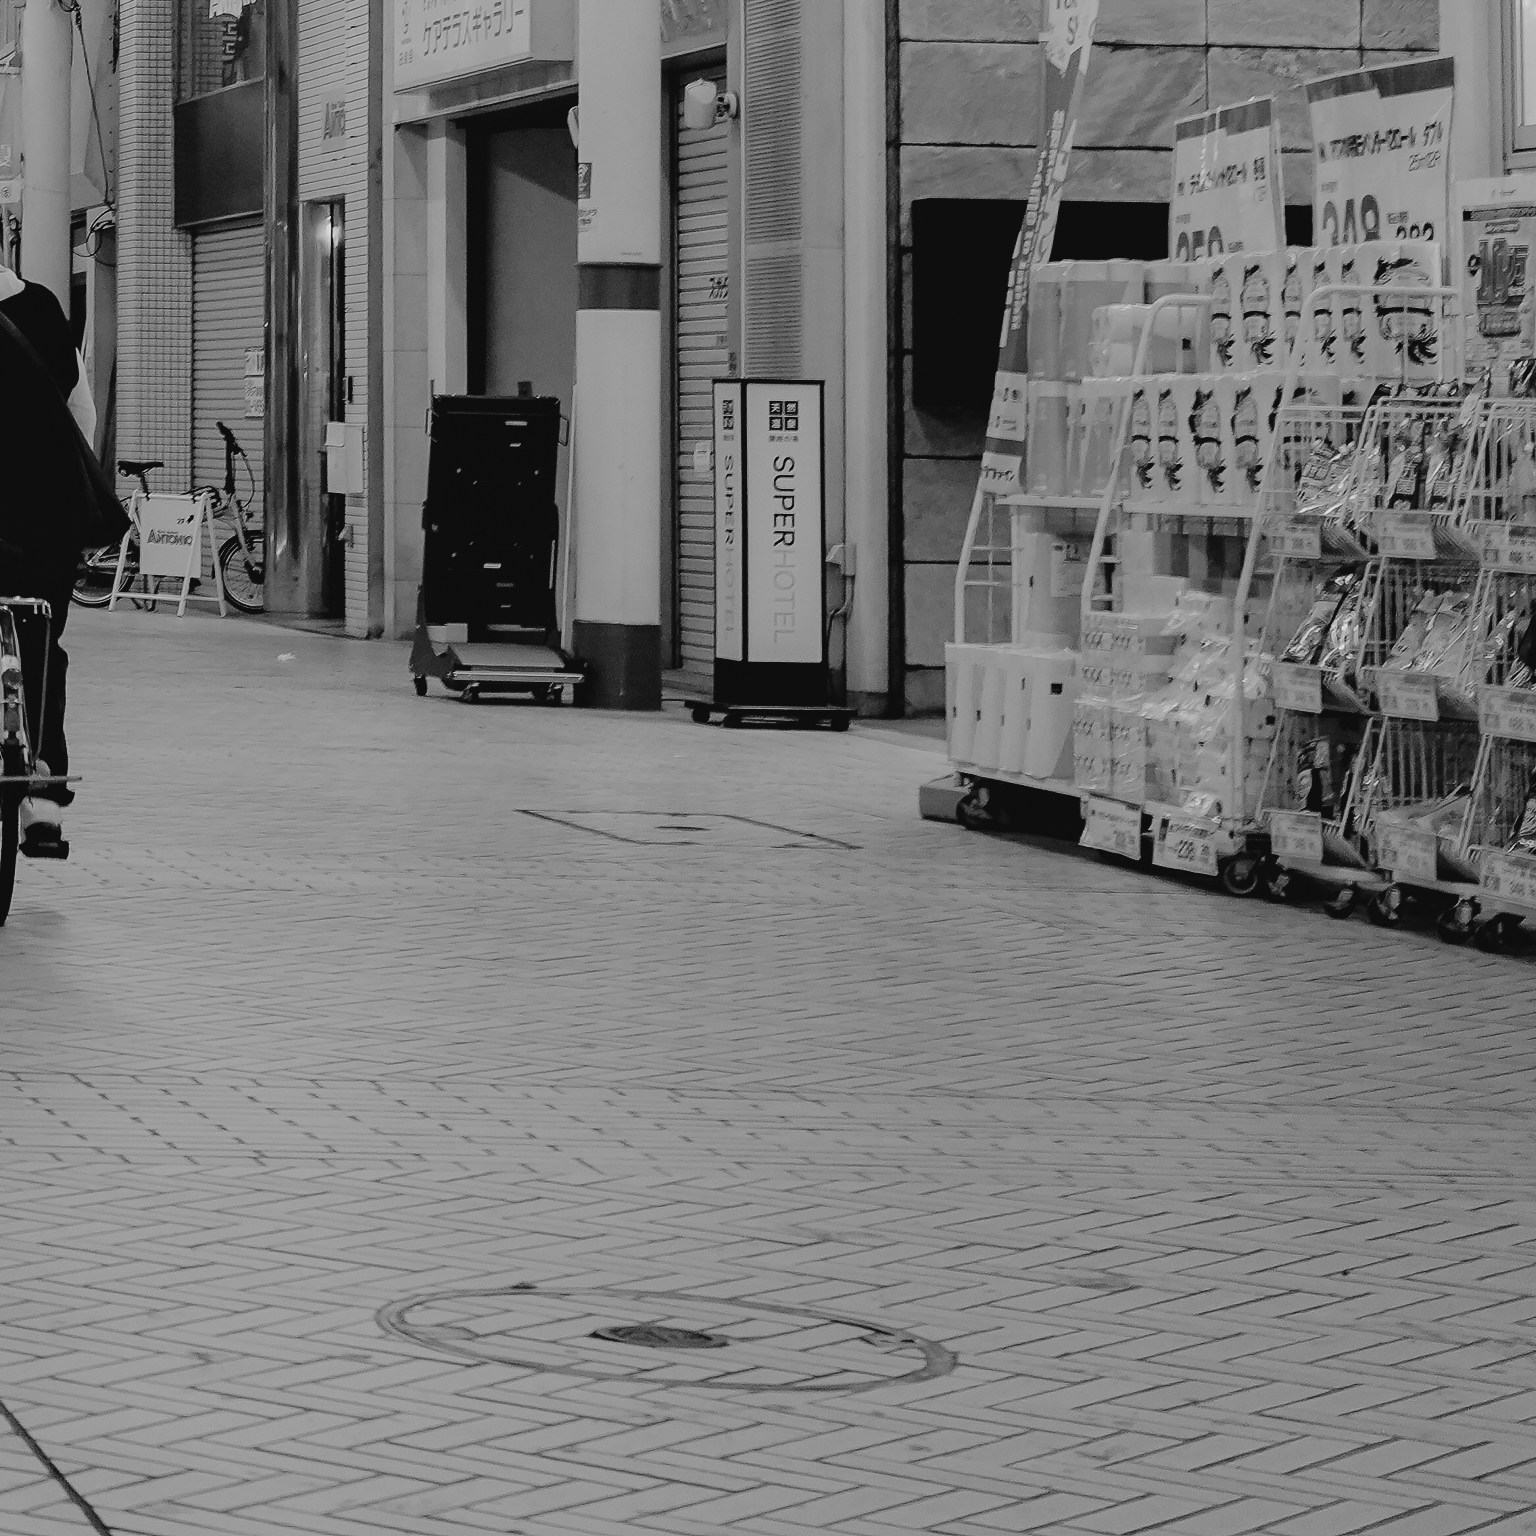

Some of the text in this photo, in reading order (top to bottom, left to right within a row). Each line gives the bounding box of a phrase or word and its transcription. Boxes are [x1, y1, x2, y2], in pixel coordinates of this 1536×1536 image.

[768, 400, 798, 415] 天然
[146, 529, 193, 546] ANTONIO
[772, 455, 796, 644] SUPER HOTEL
